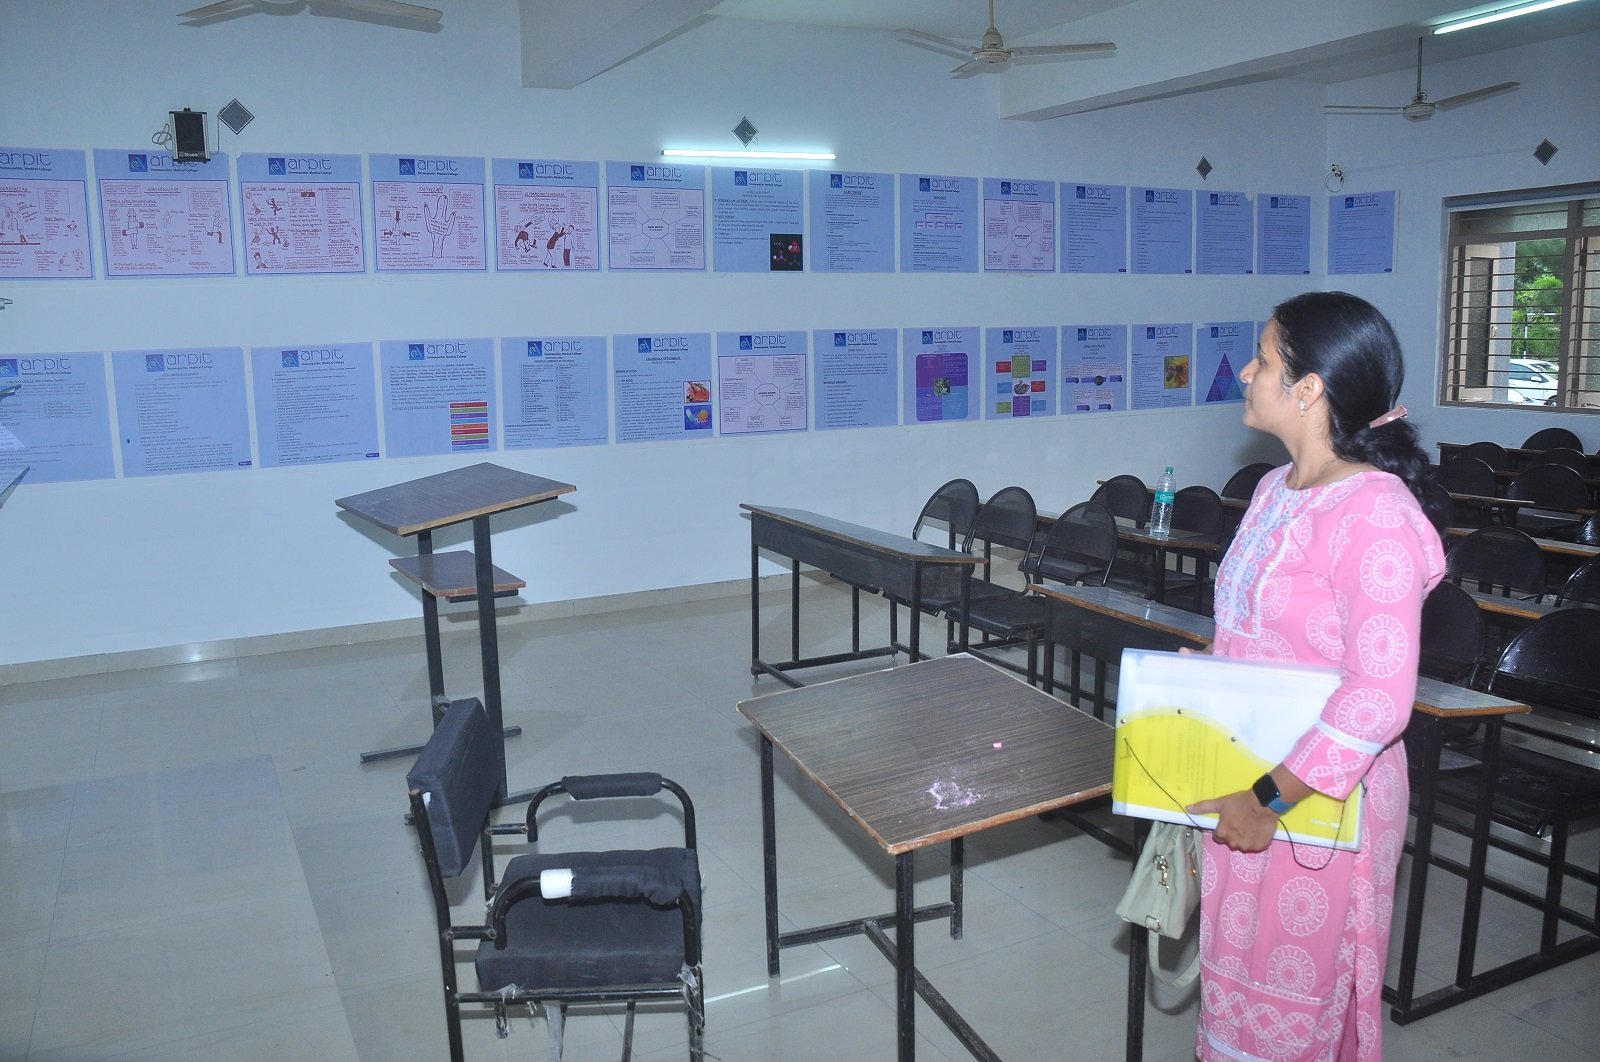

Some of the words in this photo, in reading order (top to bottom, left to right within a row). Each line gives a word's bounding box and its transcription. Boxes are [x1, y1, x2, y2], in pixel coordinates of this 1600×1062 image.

[0, 153, 52, 166] arpit
[287, 158, 332, 170] arpit
[417, 159, 458, 171] arpit
[535, 164, 574, 175] arpit
[646, 167, 682, 177] arpit
[748, 172, 782, 182] arpit
[844, 176, 875, 185] arpit
[931, 179, 960, 188] arpit
[1012, 182, 1039, 192] arpit
[1086, 188, 1111, 196] arpit
[847, 332, 878, 342] arpit
[934, 330, 962, 340] arpit
[1014, 330, 1040, 340] arpit
[1088, 328, 1112, 336] arpit
[653, 337, 689, 348] arpit
[753, 335, 786, 345] arpit
[426, 343, 467, 354] arpit
[544, 341, 582, 352] arpit
[166, 353, 213, 365] arpit
[300, 348, 344, 360] arpit
[20, 358, 72, 370] arpit
